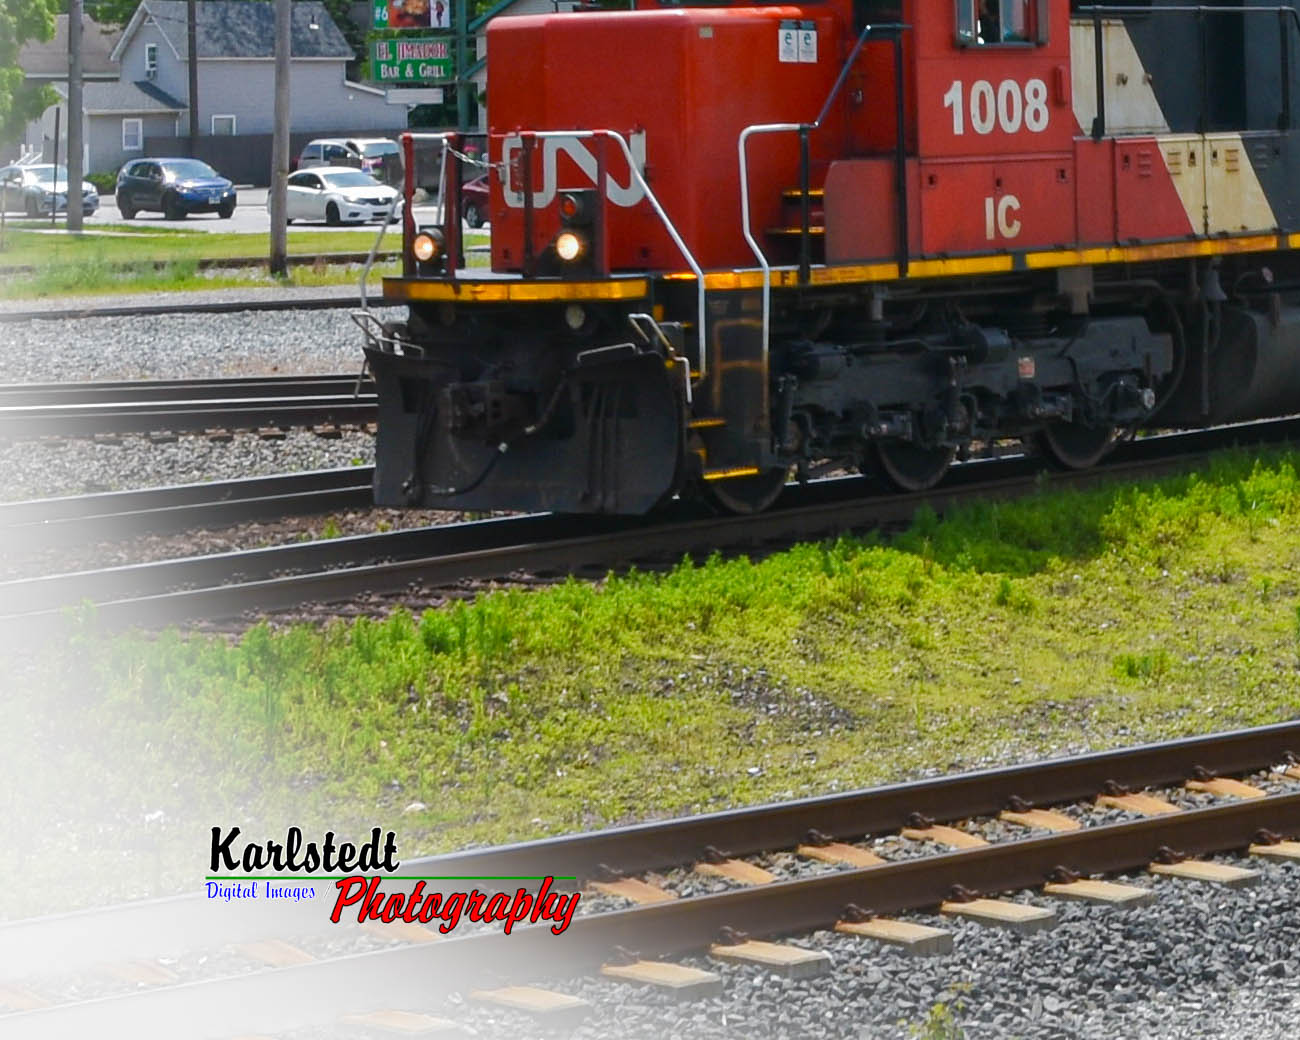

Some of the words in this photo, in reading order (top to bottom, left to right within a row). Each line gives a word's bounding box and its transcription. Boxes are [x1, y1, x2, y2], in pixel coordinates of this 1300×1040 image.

[374, 5, 389, 21] #6
[405, 63, 415, 78] &
[943, 78, 1050, 136] 1008
[501, 130, 647, 209] CN
[984, 194, 1022, 241] IC
